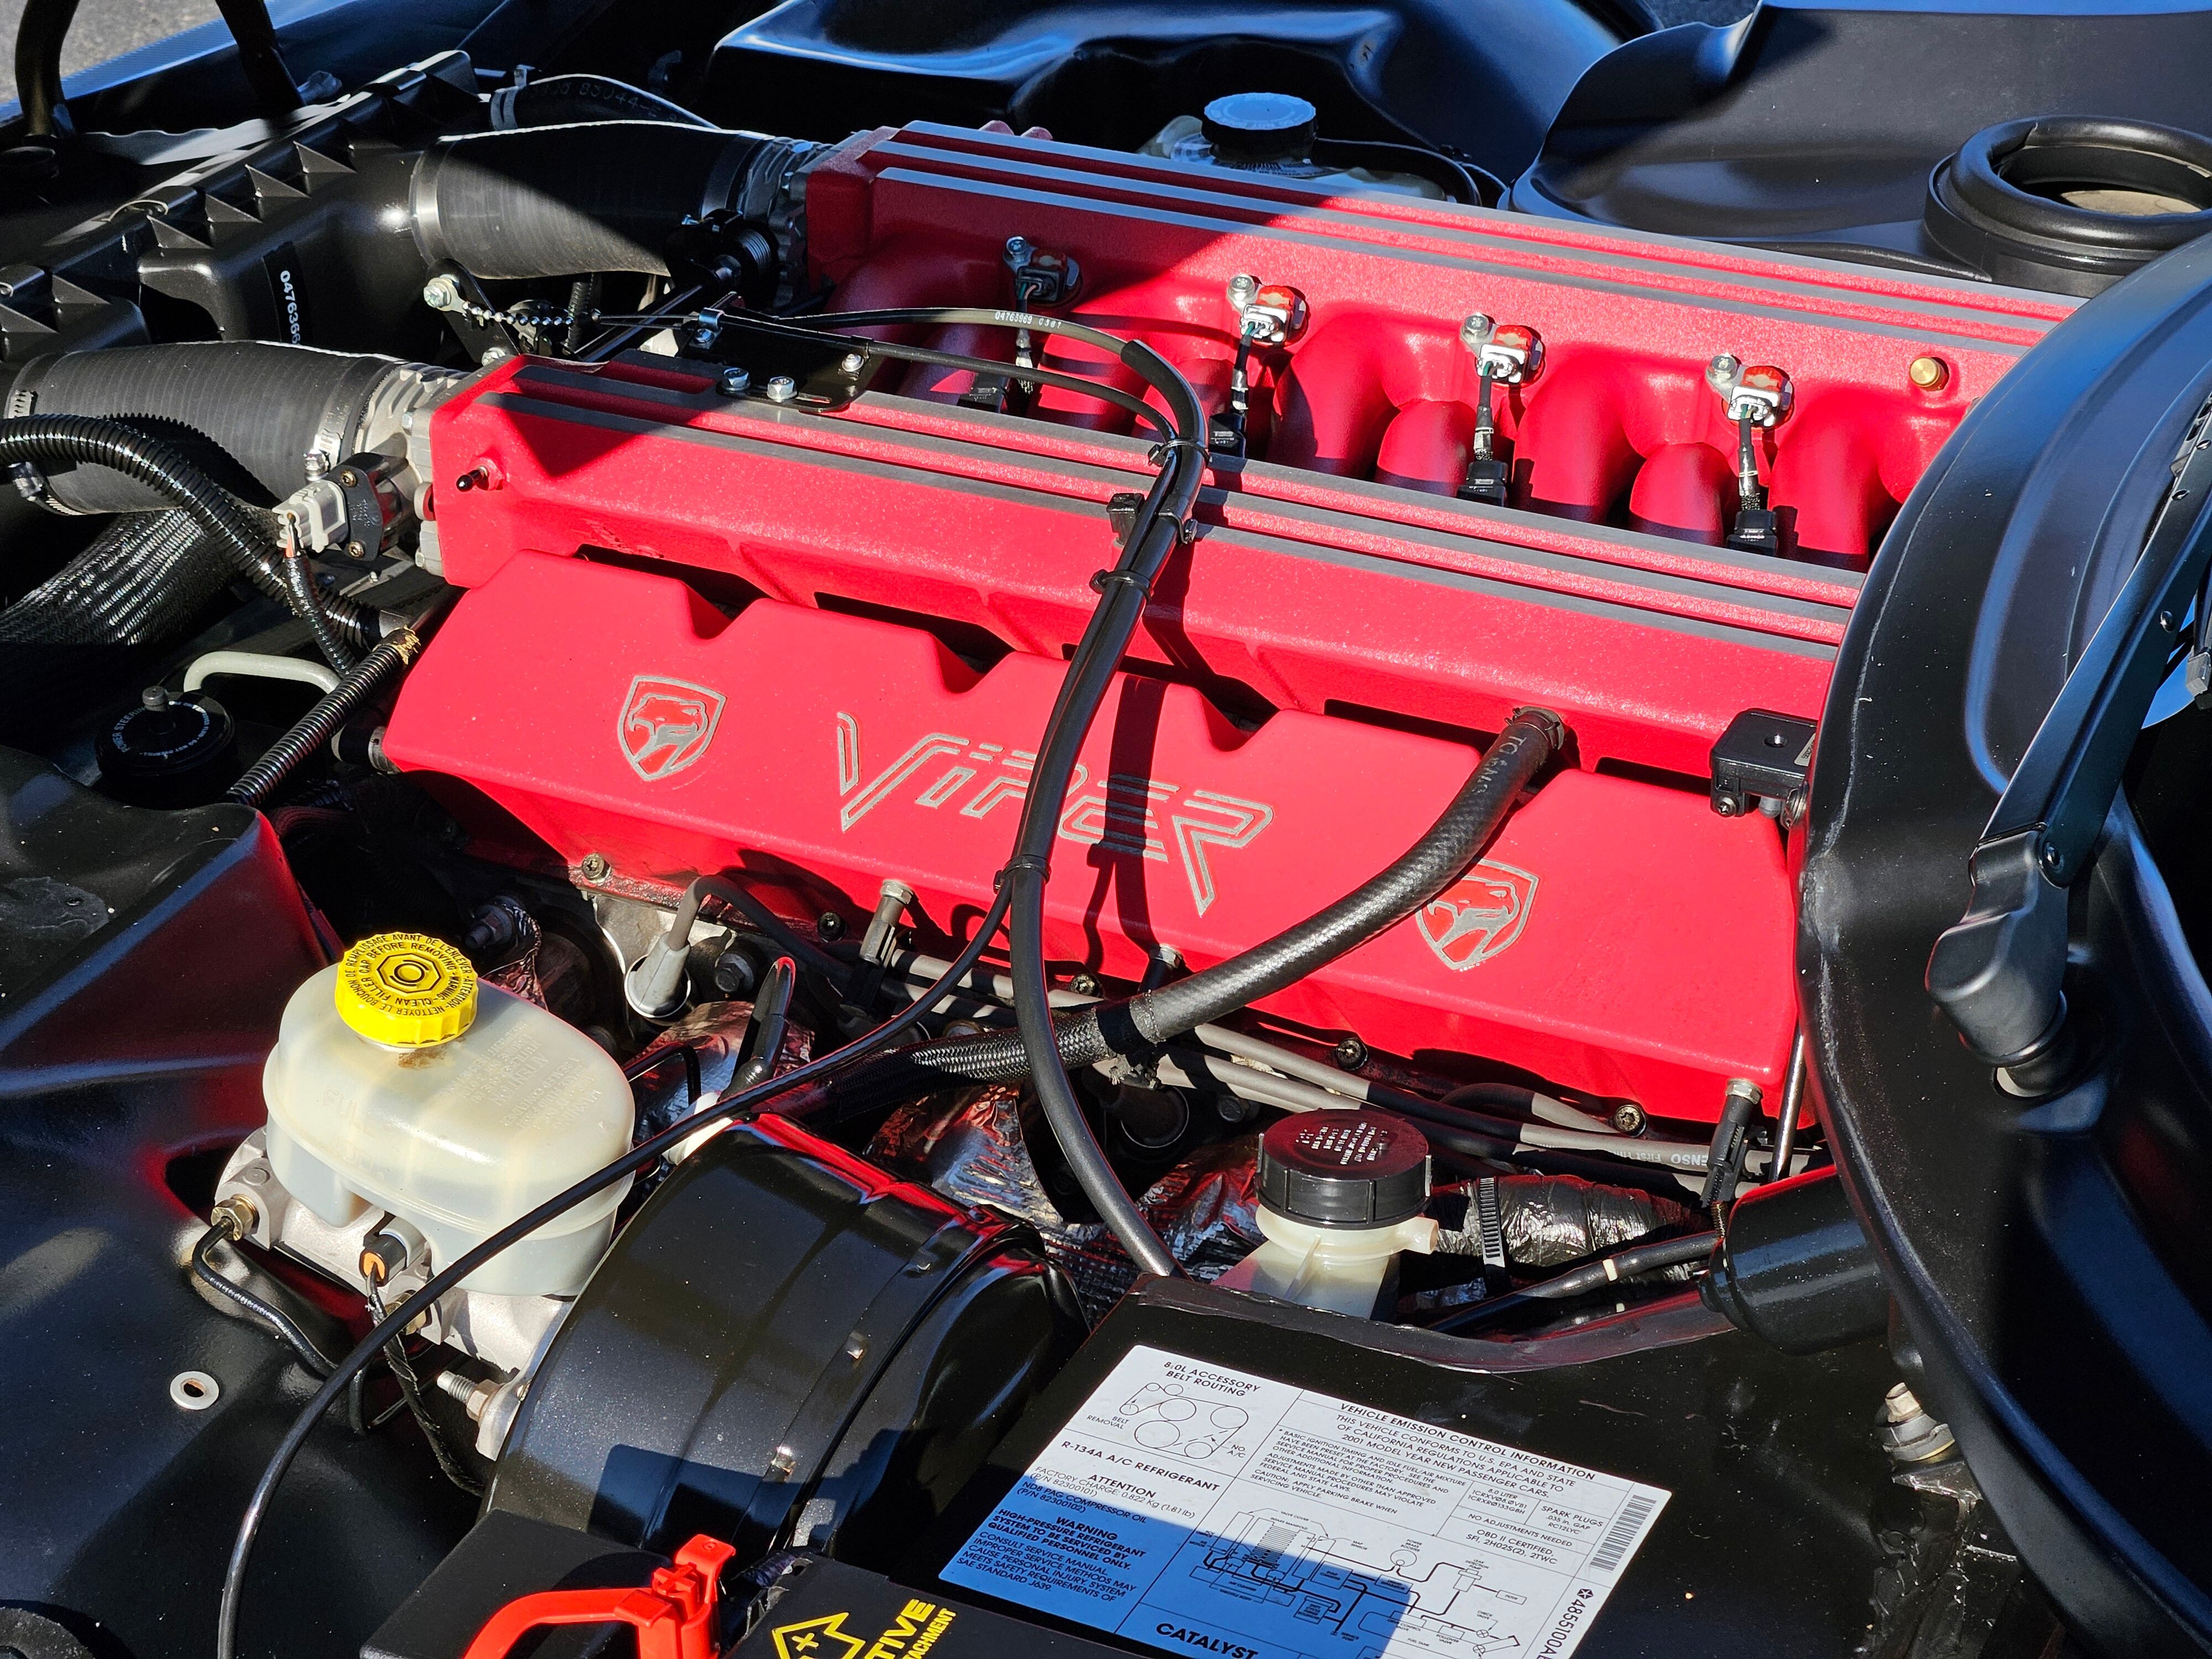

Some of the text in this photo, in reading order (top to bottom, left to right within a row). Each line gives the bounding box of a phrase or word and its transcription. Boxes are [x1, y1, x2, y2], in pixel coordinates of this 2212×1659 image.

[114, 707, 145, 730] STEERIN
[366, 942, 405, 958] BEFORE
[411, 943, 456, 970] REMOVING
[359, 959, 371, 973] CAP
[361, 977, 391, 1000] FILLER
[379, 1004, 393, 1012] LE
[395, 998, 431, 1006] CLEAN
[397, 1006, 445, 1016] NETTOYER
[1671, 1154, 1708, 1166] ENSO
[1165, 1370, 1245, 1396] BELT ROUTING
[1188, 1369, 1260, 1391] ACCESSORY
[1086, 1415, 1123, 1429] REMOVAL
[1112, 1416, 1129, 1424] BELT
[1280, 1436, 1300, 1444] HAVE
[1301, 1442, 1319, 1450] BEEN
[1319, 1447, 1344, 1457] PRESET
[1336, 1414, 1357, 1424] THIS
[1359, 1420, 1400, 1437] VEHICLE
[1401, 1433, 1460, 1454] CONFORMS
[1499, 1461, 1517, 1471] EPA
[1520, 1468, 1544, 1478] AND
[1546, 1474, 1575, 1486] STATE
[1341, 1403, 1595, 1480] VEHICLE EMISSION CONTROL INFORMATION
[1061, 1441, 1220, 1490] R-134A A/C REFRIGERANT
[1272, 1446, 1296, 1455] OTHER
[1296, 1453, 1339, 1468] ADDITIONAL
[1276, 1441, 1306, 1452] SERVICE
[1306, 1449, 1337, 1462] MANUAL
[1354, 1463, 1383, 1474] PROPER
[1384, 1472, 1431, 1488] PROCEDURES
[1284, 1431, 1306, 1440] BASIC
[1306, 1437, 1340, 1450] IGNITION
[1341, 1447, 1366, 1457] TIMING
[1402, 1465, 1434, 1477] FUEL/AIR
[1434, 1474, 1466, 1486] MIXTURE
[1341, 1434, 1548, 1498] 2001 MODEL YEAR NEW PASSENGER CARS.
[1353, 1428, 1412, 1450] CALIFORNIA
[1416, 1446, 1485, 1470] REGULATIONS
[1486, 1467, 1548, 1488] APPLICABLE
[1550, 1483, 1563, 1491] TO
[1027, 1473, 1097, 1497] (P/N 82300101)
[1035, 1466, 1078, 1485] FACTORY
[1077, 1479, 1120, 1495] CHARGE:
[1121, 1491, 1146, 1503] 0.822
[1146, 1499, 1160, 1508] Kg
[1087, 1474, 1156, 1498] ATTENTION
[1016, 1488, 1086, 1513] (P/N 82300102)
[1022, 1481, 1146, 1524] ND8 PAG COMPRESSOR OIL
[1056, 1516, 1118, 1540] WARNING
[1541, 1506, 1603, 1526] SPARK PLUGS
[992, 1515, 1031, 1531] SYSTEM
[1032, 1526, 1046, 1535] TO
[1047, 1532, 1061, 1540] BE
[1061, 1536, 1112, 1555] SERVICED
[997, 1508, 1146, 1557] HIGH-PRESSURE REFRIGERANT
[1477, 1529, 1498, 1538] OBD
[1483, 1518, 1539, 1537] ADJUSTMENTS
[1540, 1534, 1572, 1546] NEEDED
[979, 1531, 1025, 1549] CONSULT
[1024, 1545, 1065, 1562] SERVICE
[988, 1522, 1131, 1570] QUALIFIED PERSONNEL ONLY.
[1529, 1552, 1557, 1564] 2TWC
[956, 1557, 976, 1567] SAE
[975, 1563, 1027, 1583] STANDARD
[962, 1551, 993, 1564] MEETS
[993, 1560, 1027, 1574] SAFETY
[1026, 1571, 1100, 1597] REQUIREMENTS
[968, 1545, 1001, 1558] CAUSE
[1000, 1554, 1050, 1574] PERSONAL
[1088, 1581, 1126, 1597] SYSTEM
[973, 1537, 1136, 1592] IMPROPER SERVICE METHODS MAY
[864, 1599, 936, 1659] TIVE
[902, 1608, 956, 1659] TACHMENT
[1156, 1623, 1259, 1659] CATALYST
